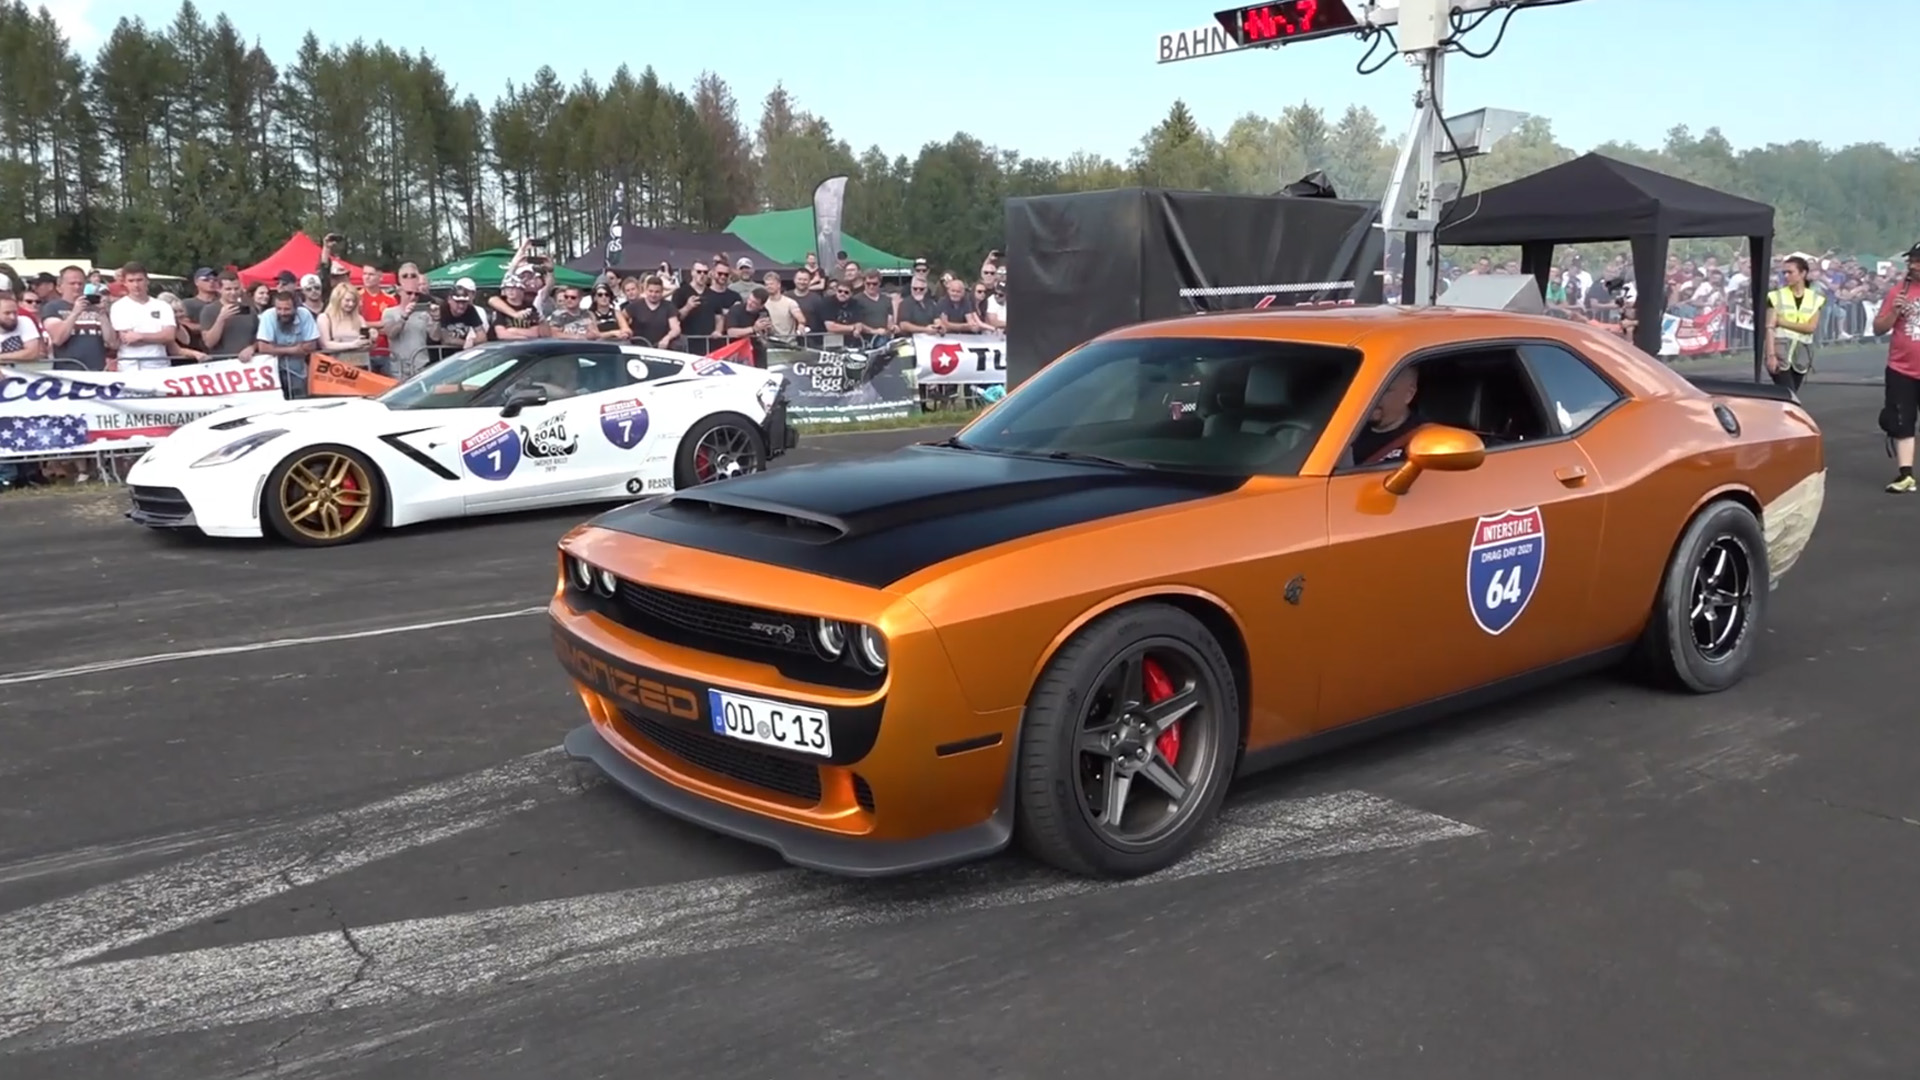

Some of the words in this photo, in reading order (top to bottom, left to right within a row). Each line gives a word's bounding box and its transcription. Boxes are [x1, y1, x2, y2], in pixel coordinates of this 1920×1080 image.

[1159, 26, 1228, 60] BAHN
[793, 362, 843, 376] Green
[818, 351, 846, 367] Big
[163, 365, 275, 398] STRIPES
[811, 376, 843, 392] Egg
[96, 413, 121, 430] THE
[124, 410, 196, 428] AMERICAN
[618, 420, 633, 443] 7
[534, 424, 567, 445] ROAD
[487, 449, 502, 472] 7
[1483, 518, 1533, 542] INTERSTATE
[1481, 549, 1502, 563] DRAG
[1503, 547, 1518, 559] DAY
[1486, 565, 1521, 609] 64
[725, 701, 755, 735] OD
[770, 710, 787, 742] C
[792, 715, 826, 749] 13
